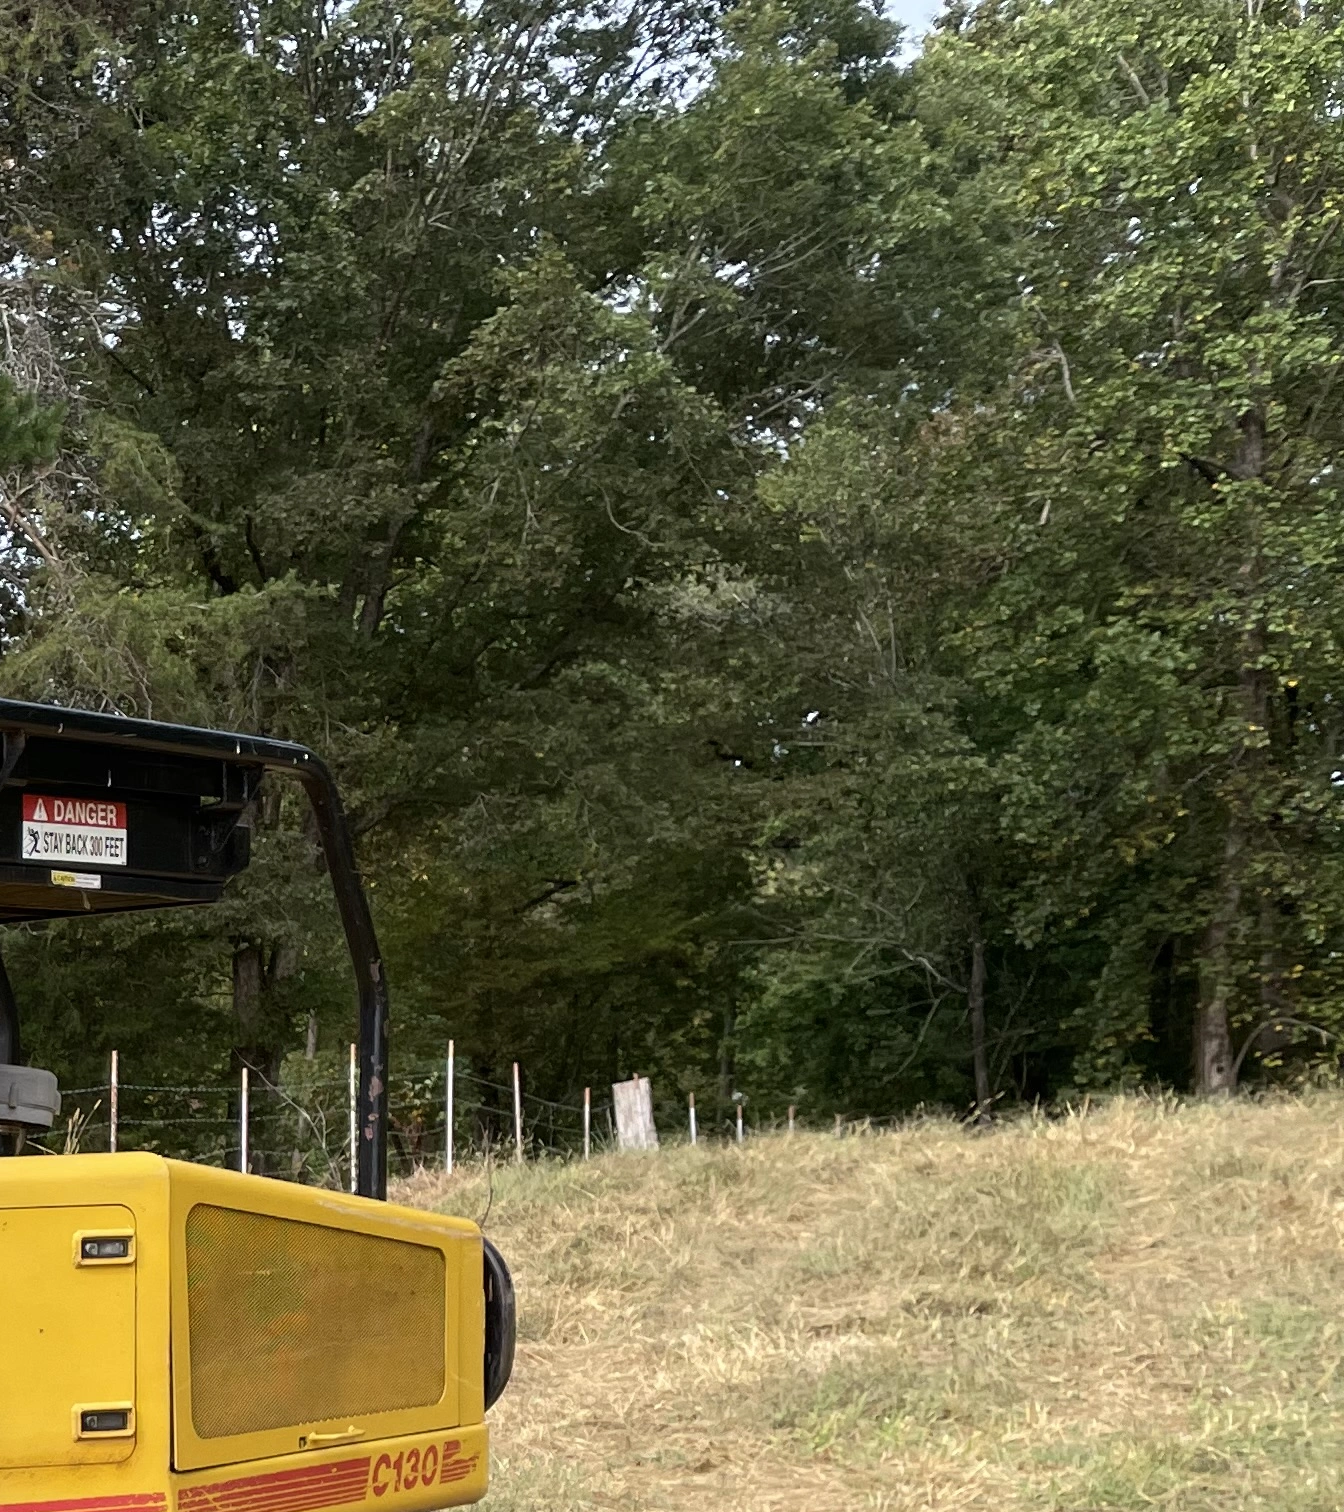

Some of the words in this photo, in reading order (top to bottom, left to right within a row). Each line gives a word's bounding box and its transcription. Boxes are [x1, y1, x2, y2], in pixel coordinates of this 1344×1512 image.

[54, 800, 117, 827] DANGER
[43, 832, 64, 853] STAY
[65, 834, 88, 856] BACK
[90, 835, 103, 856] 300
[105, 837, 124, 857] FEET
[372, 1444, 439, 1497] C130
